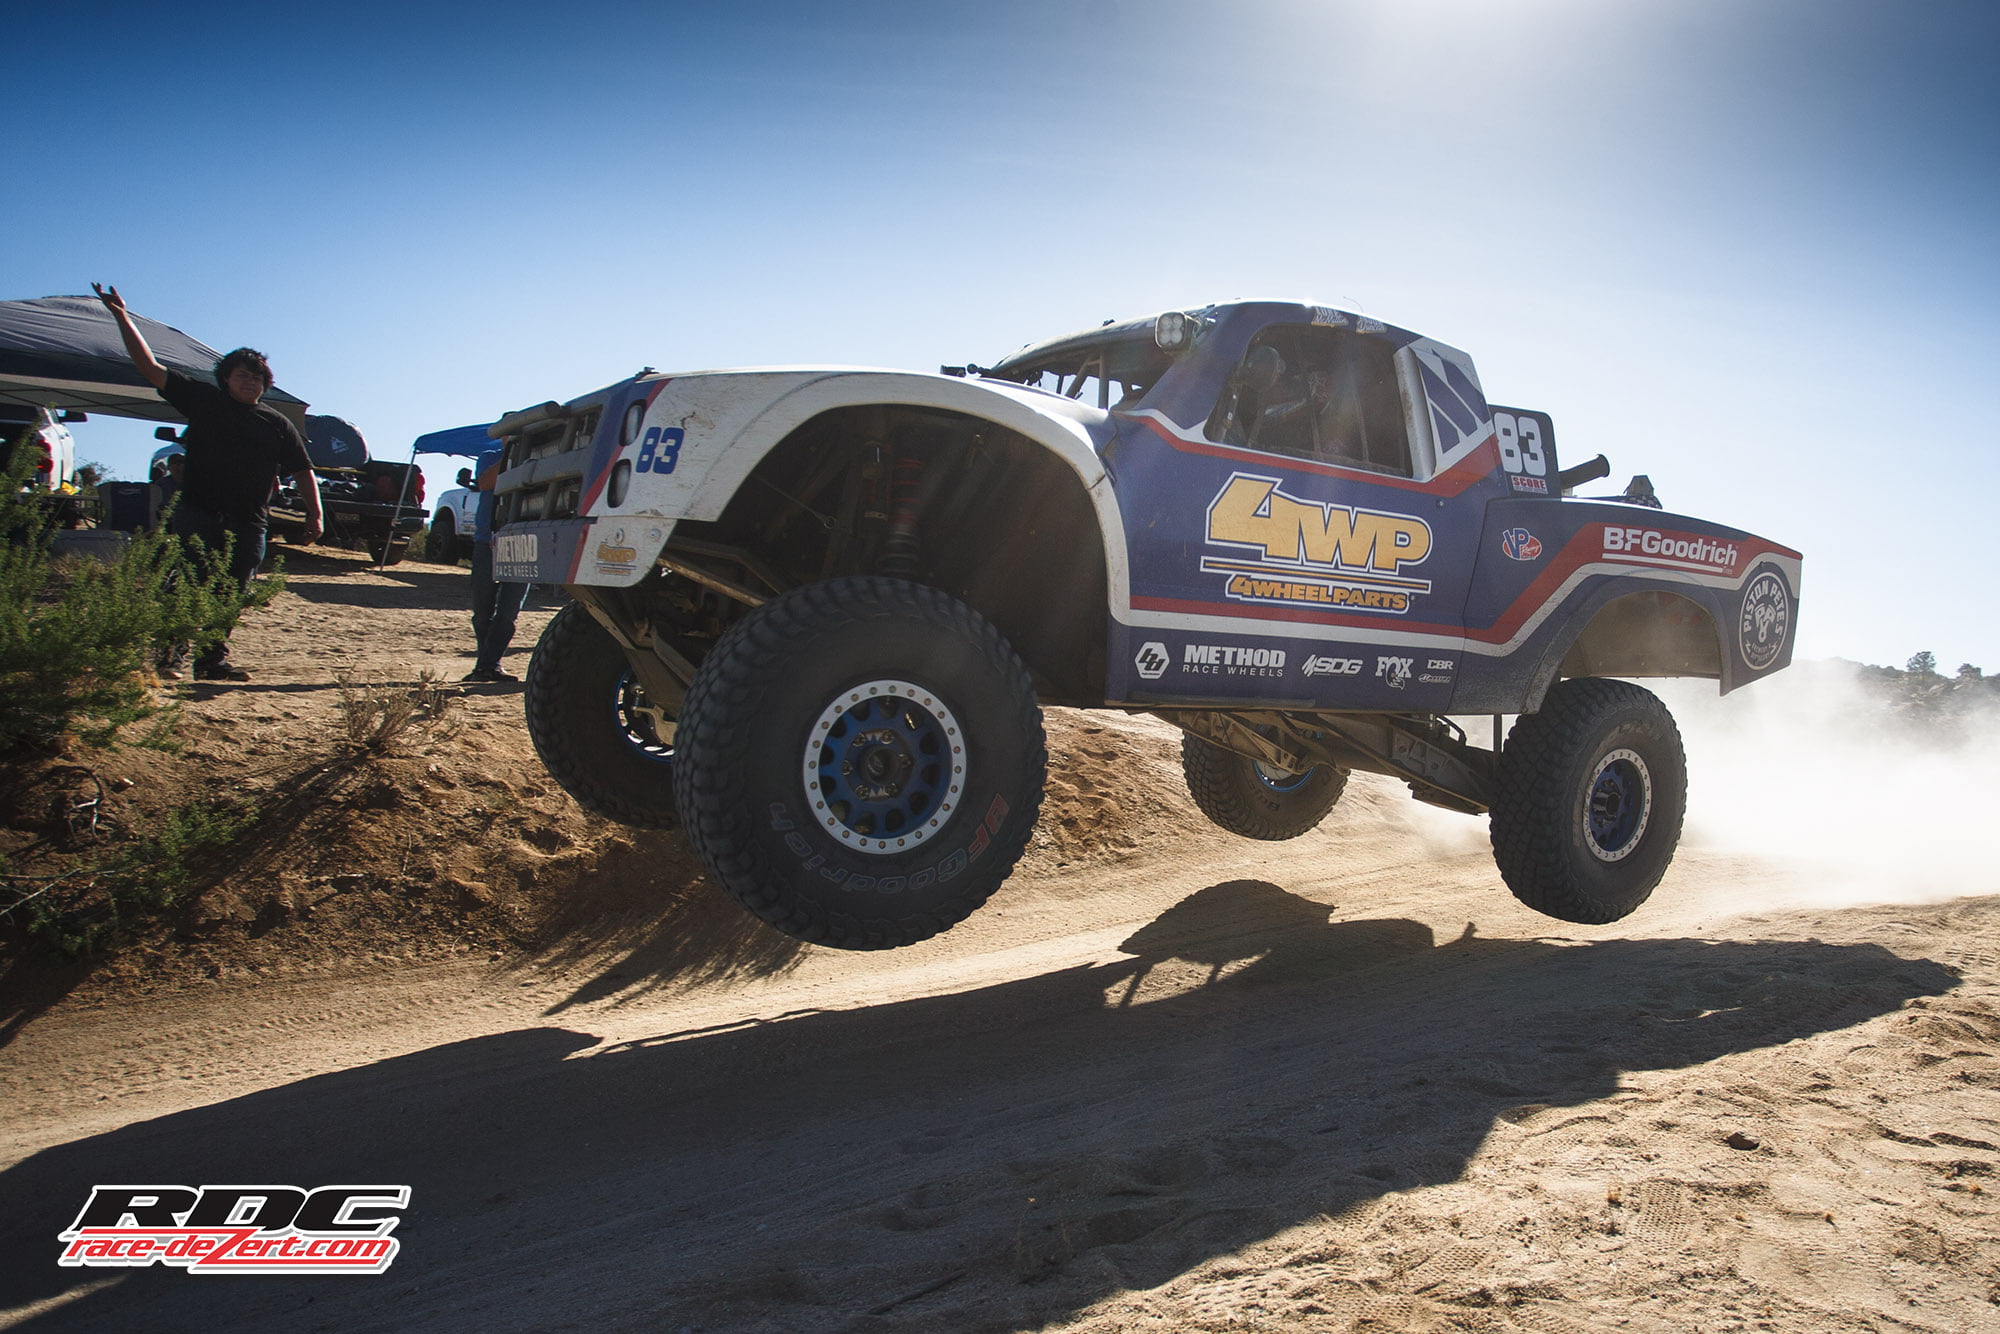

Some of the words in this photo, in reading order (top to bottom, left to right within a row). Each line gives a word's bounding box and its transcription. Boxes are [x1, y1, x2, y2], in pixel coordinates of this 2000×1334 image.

[635, 426, 685, 474] 83
[1494, 412, 1546, 477] 83
[1512, 476, 1546, 489] SCORE
[1206, 474, 1432, 574] 4WP
[496, 534, 538, 562] METHOD
[1503, 527, 1530, 560] VP
[1603, 526, 1737, 566] BFGoodrich
[1743, 579, 1769, 633] PISTON
[1184, 644, 1287, 668] METHOD
[1313, 656, 1364, 674] SDG
[1375, 656, 1414, 682] FOX
[1427, 659, 1454, 671] CBR
[1182, 664, 1220, 674] RACE
[1227, 666, 1284, 678] WHEELS
